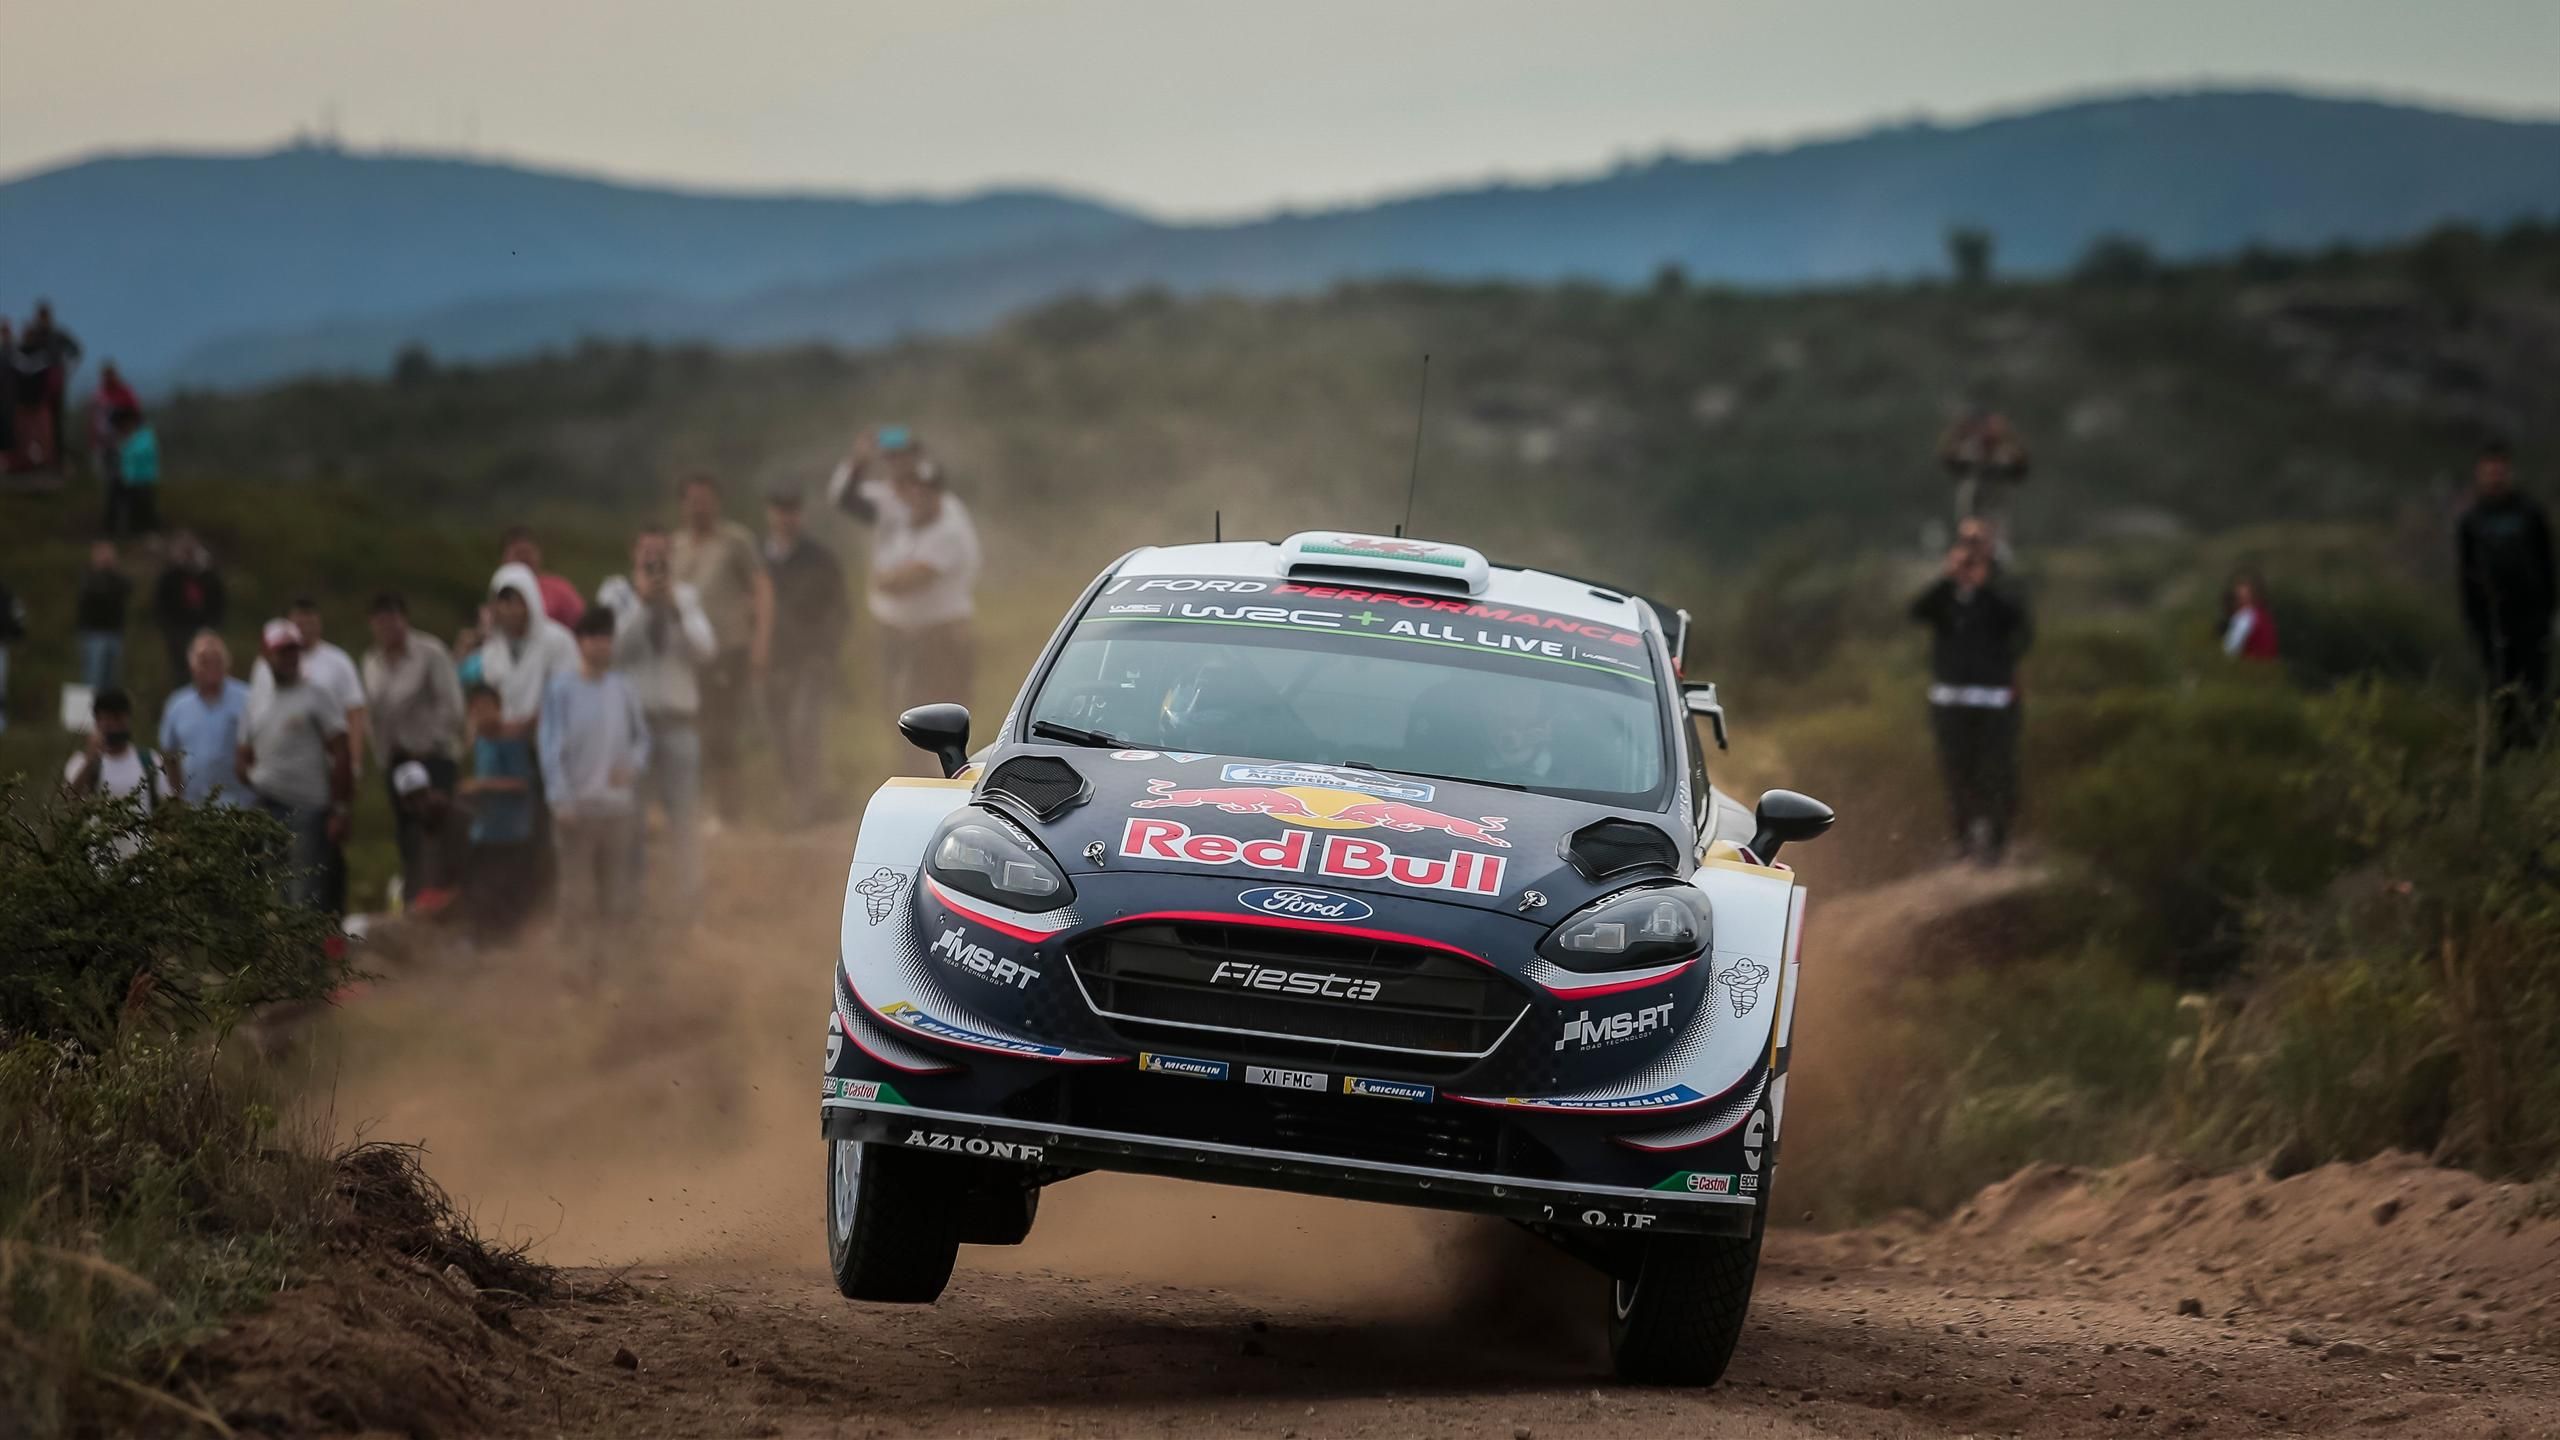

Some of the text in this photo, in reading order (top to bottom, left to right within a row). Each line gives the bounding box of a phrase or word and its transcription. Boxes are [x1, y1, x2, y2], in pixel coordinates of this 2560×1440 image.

[1136, 579, 1643, 647] FORD PERFORMANCE
[1389, 620, 1465, 642] ALL
[1477, 630, 1563, 657] LIVE
[1246, 773, 1347, 786] Argentina
[1121, 818, 1505, 895] Red Bull
[1263, 890, 1348, 917] Ford
[1210, 961, 1381, 1001] Fiesta
[919, 1022, 1041, 1052] MICHELIN
[1164, 1060, 1221, 1075] MICHELIN
[1282, 1070, 1313, 1088] FMC
[848, 1082, 877, 1099] Castrol
[1369, 1084, 1426, 1098] MICHELIN
[1561, 1093, 1680, 1108] MICHELIN
[1699, 1176, 1728, 1191] Castrol
